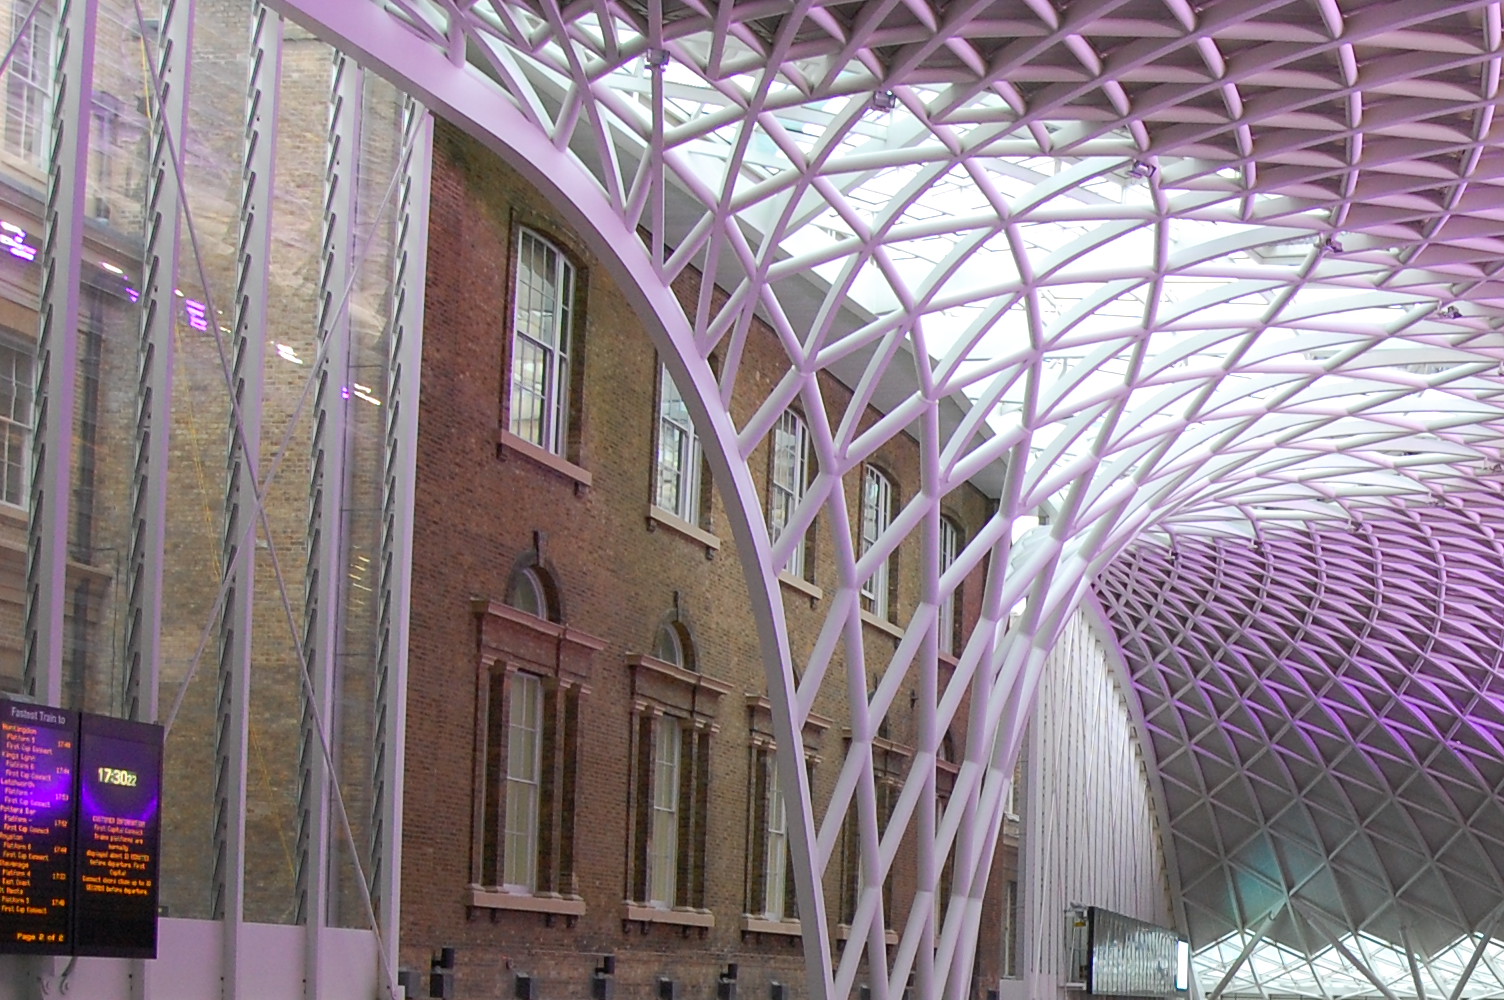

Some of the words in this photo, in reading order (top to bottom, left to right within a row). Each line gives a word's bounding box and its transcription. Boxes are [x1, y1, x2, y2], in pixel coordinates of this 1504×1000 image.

[11, 706, 38, 720] Fastest
[39, 711, 57, 723] Train
[58, 714, 66, 725] to
[17, 931, 36, 941] Page
